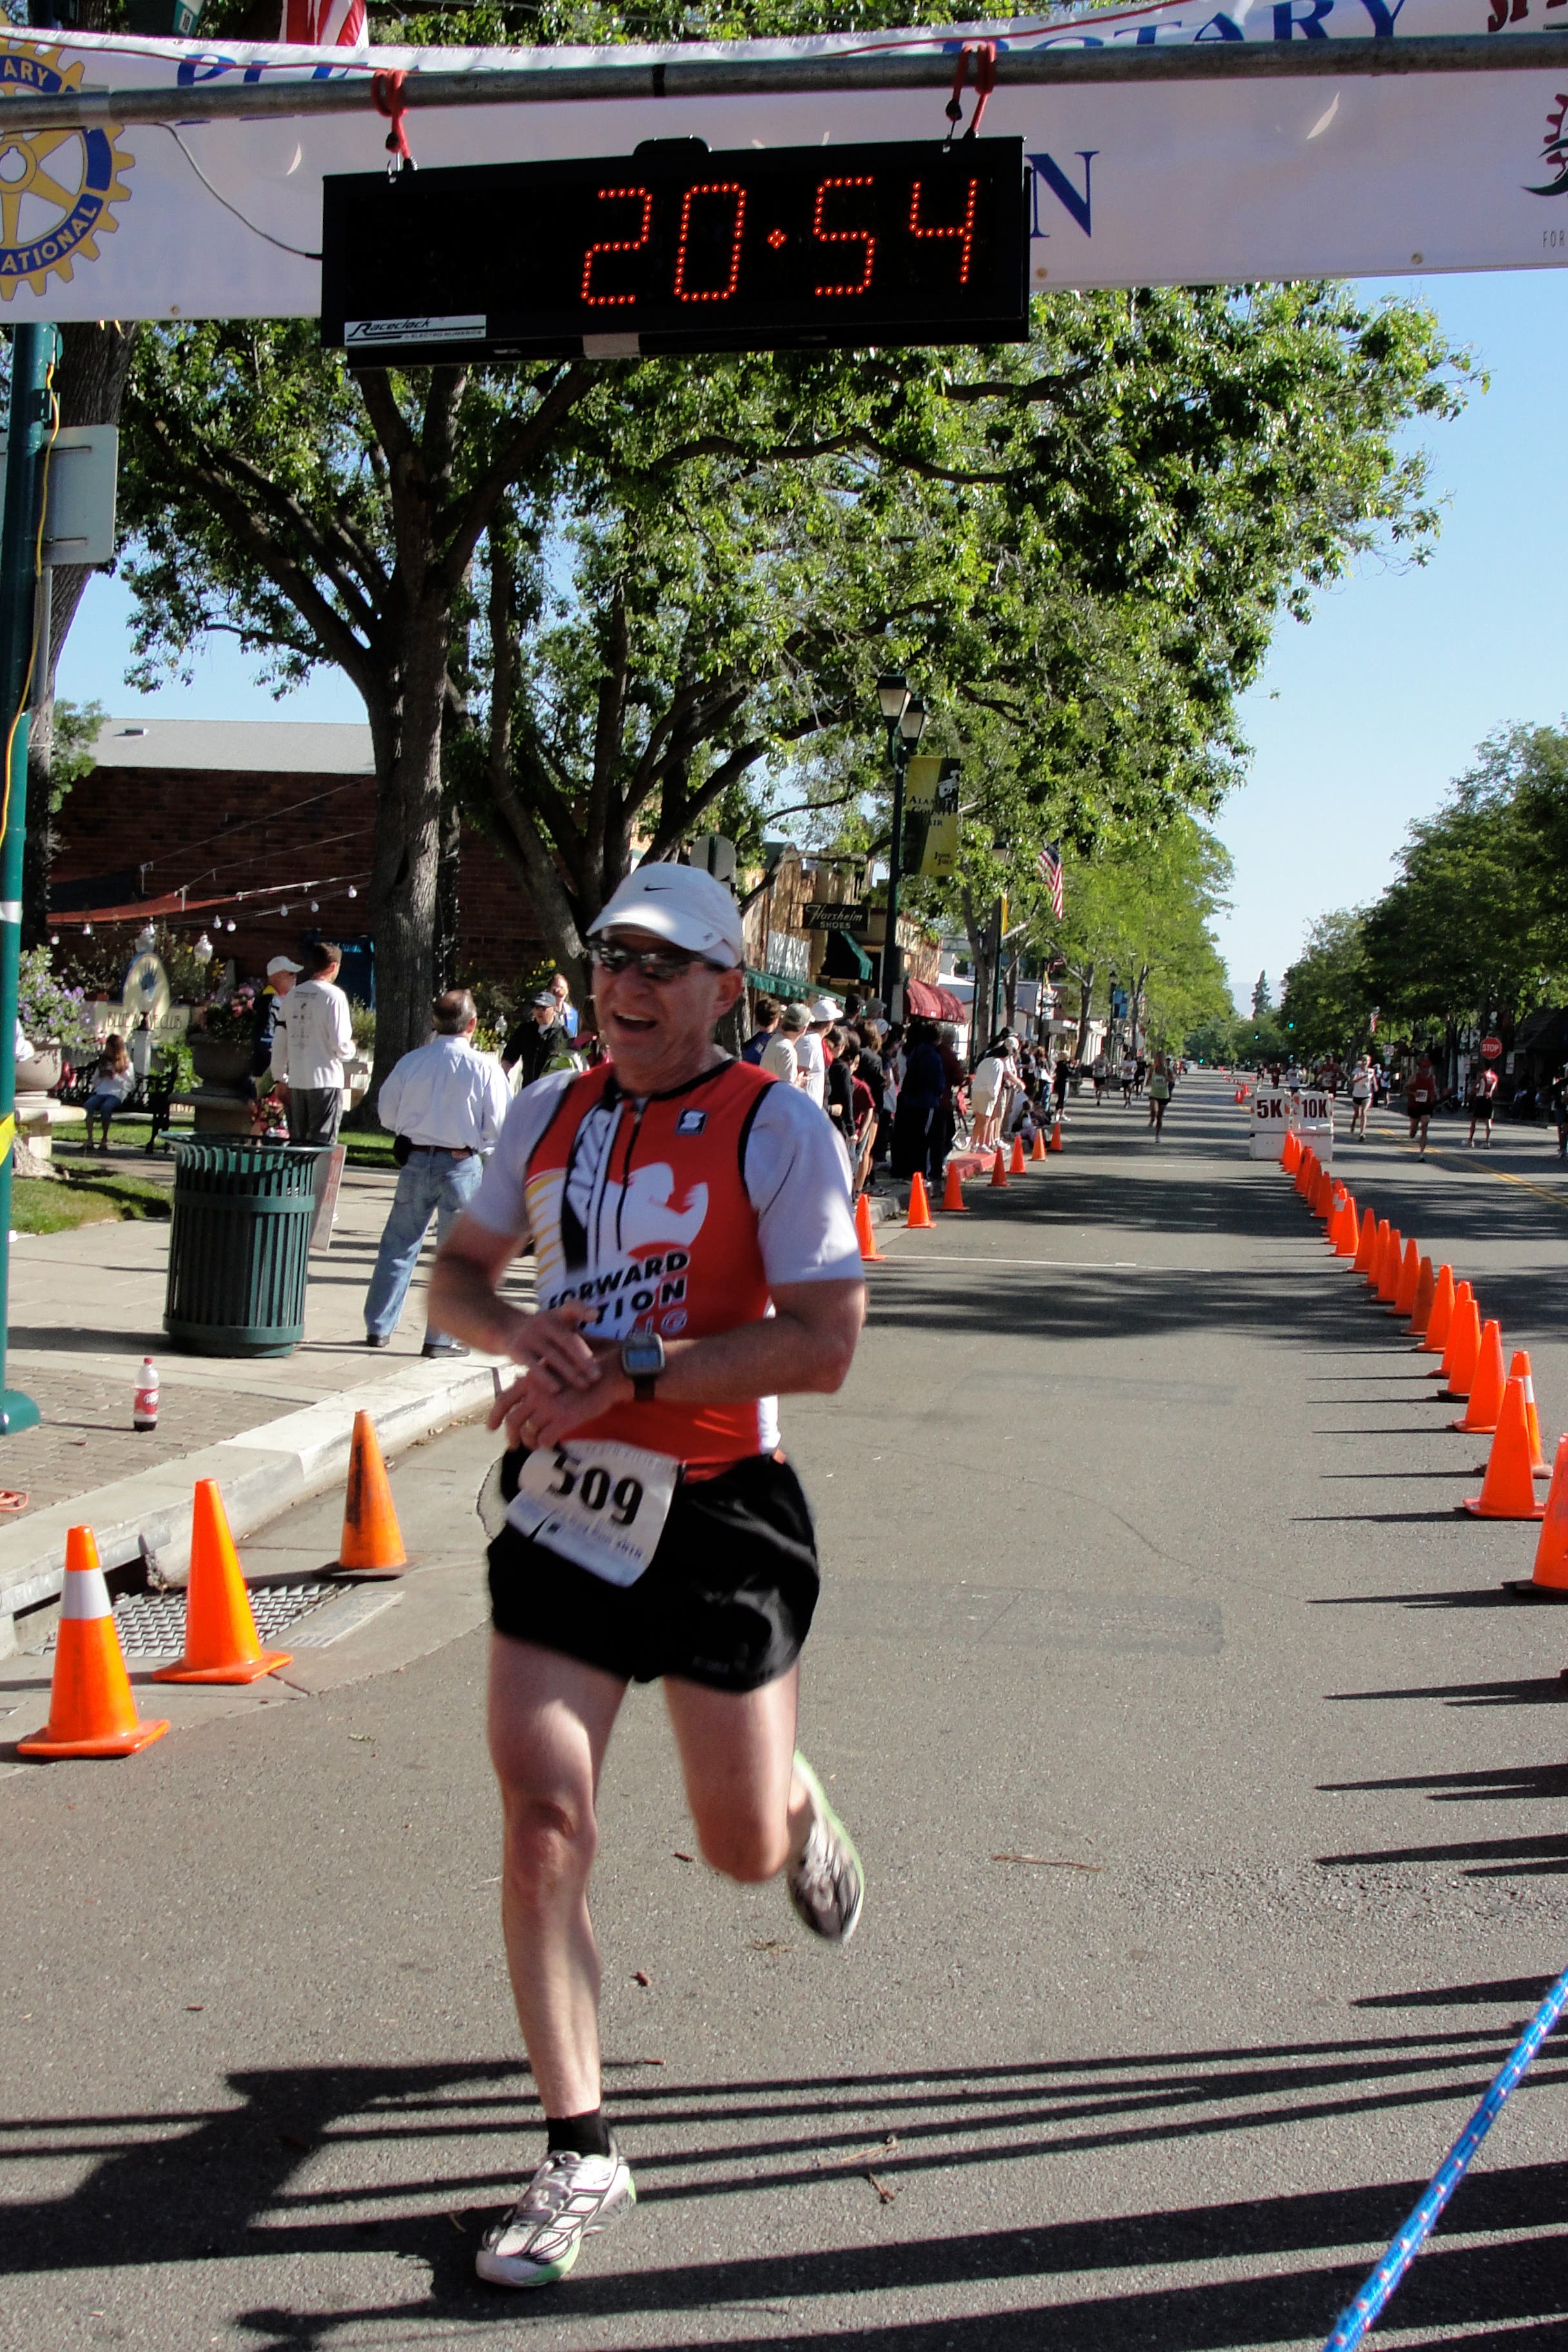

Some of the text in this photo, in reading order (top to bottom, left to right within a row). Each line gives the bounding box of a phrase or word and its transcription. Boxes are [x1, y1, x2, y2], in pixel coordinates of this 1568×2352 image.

[3, 57, 48, 87] ARY
[348, 318, 431, 337] Raceclock
[805, 904, 863, 926] Florsheim
[819, 921, 851, 929] SHOES
[160, 1014, 182, 1030] CLUB
[1482, 1043, 1500, 1052] STOP
[1256, 1098, 1283, 1119] 5K
[1300, 1098, 1328, 1119] 10K
